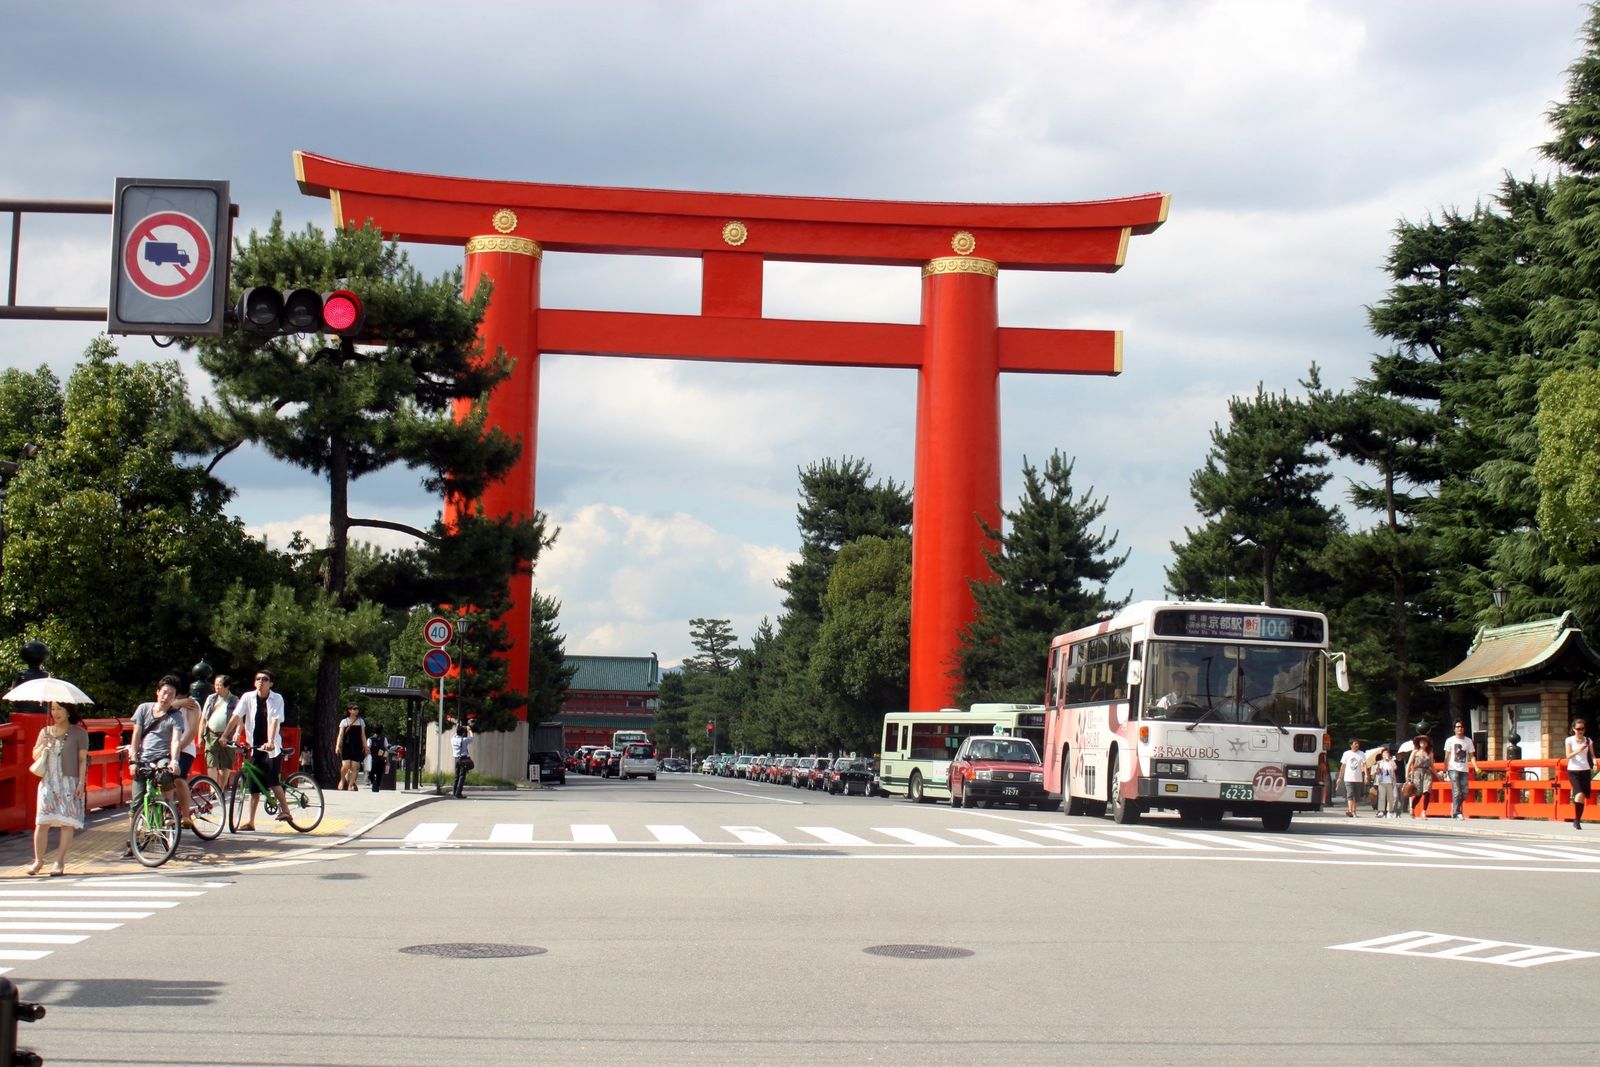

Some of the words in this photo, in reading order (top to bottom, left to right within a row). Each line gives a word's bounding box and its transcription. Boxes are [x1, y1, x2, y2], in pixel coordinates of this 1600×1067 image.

[431, 625, 446, 639] 40
[1208, 615, 1242, 630] 京都駅
[1262, 619, 1288, 637] 100
[1166, 747, 1197, 758] RAKU
[1199, 748, 1220, 759] BUS
[1255, 775, 1286, 793] 100
